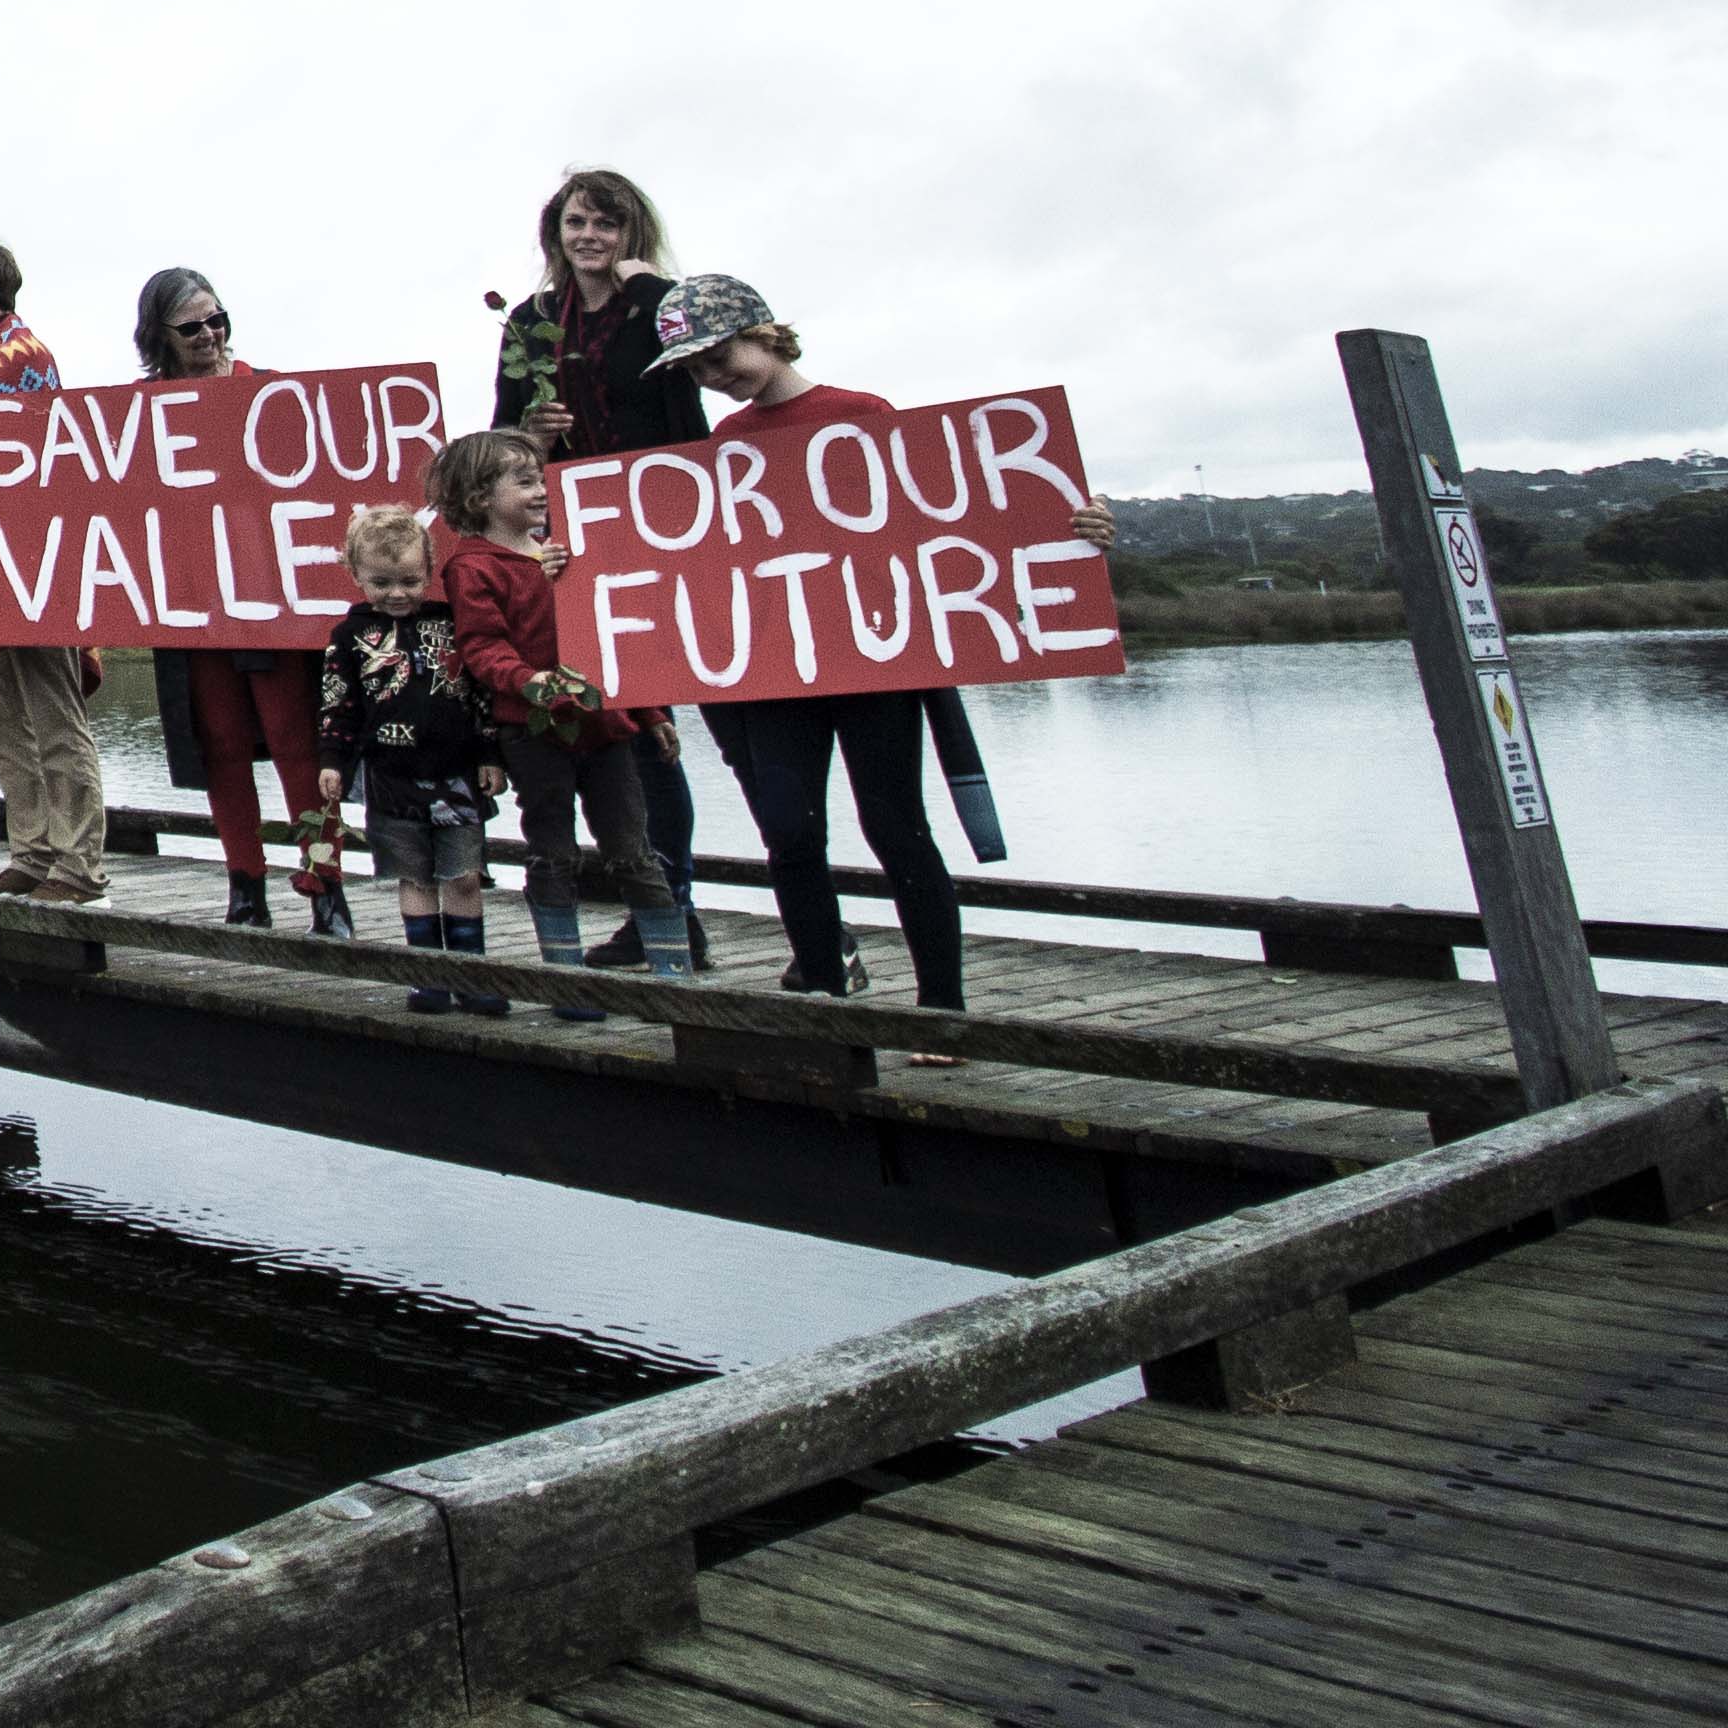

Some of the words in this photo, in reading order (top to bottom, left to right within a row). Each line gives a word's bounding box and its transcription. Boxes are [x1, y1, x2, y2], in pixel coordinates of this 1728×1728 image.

[243, 375, 445, 489] OUR
[560, 438, 784, 557] FOR
[806, 397, 1091, 534] OUR
[593, 534, 1119, 698] FUTURE
[376, 723, 415, 741] SIX
